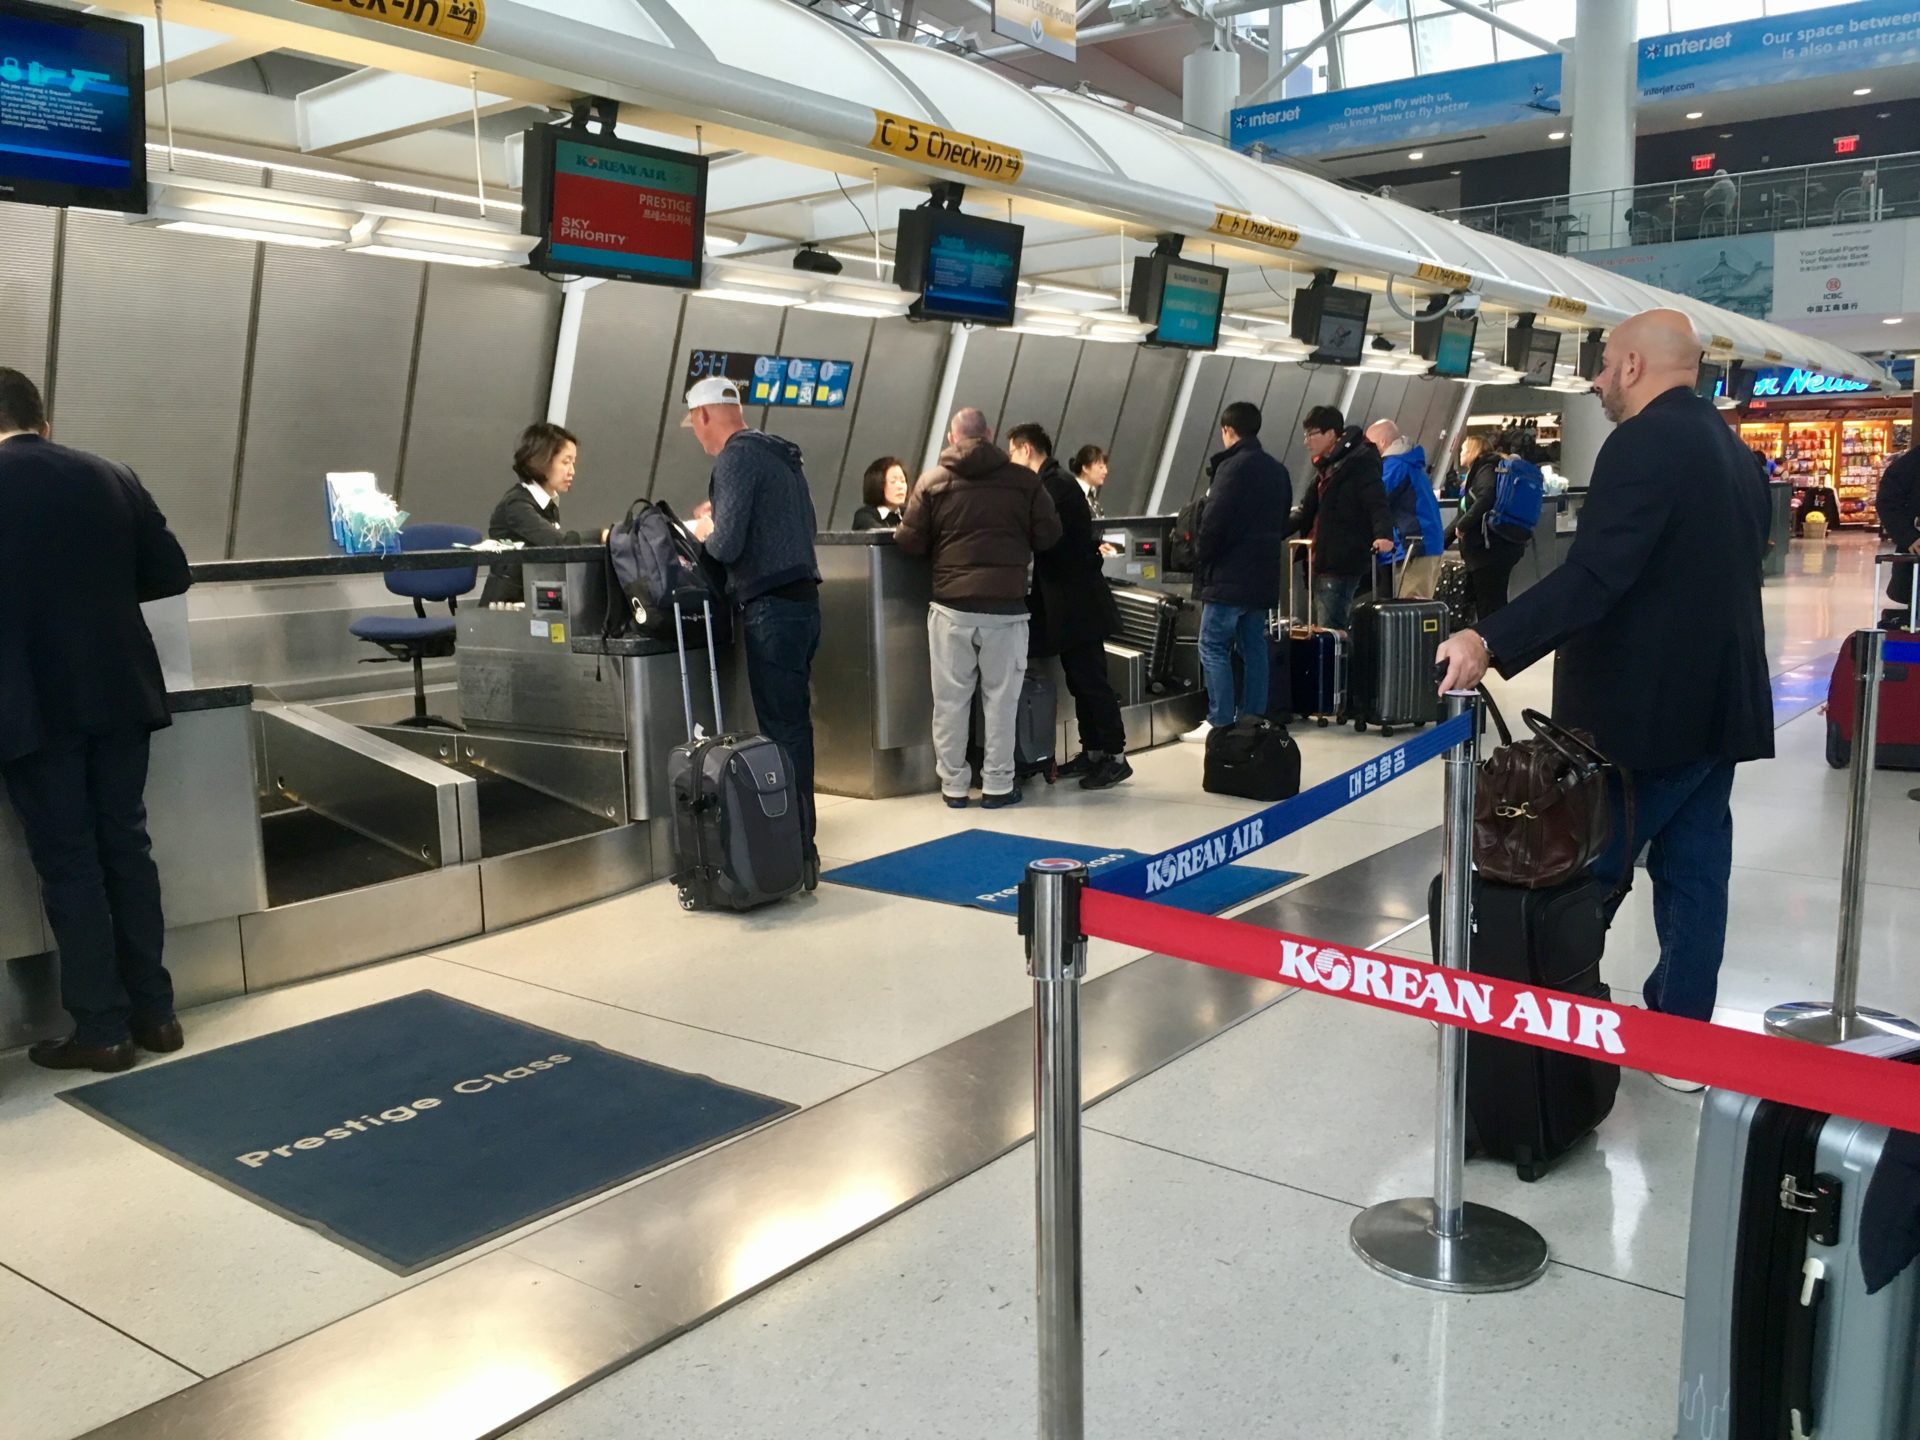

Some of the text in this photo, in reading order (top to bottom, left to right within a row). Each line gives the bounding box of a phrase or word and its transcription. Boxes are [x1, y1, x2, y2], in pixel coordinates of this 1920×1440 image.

[1762, 11, 1920, 46] Our space between
[1782, 47, 1795, 60] is
[1800, 43, 1833, 58] also
[1837, 38, 1858, 50] an
[1643, 82, 1695, 97] interjet.com
[1327, 101, 1470, 134] you know how to fly better
[1343, 106, 1370, 117] Once
[1372, 101, 1392, 113] you
[1394, 98, 1408, 109] fly
[1410, 94, 1434, 106] with
[881, 119, 1003, 174] C 5 Check-in
[576, 154, 667, 181] KOREAN AIR
[1694, 157, 1712, 170] EXIT
[639, 193, 692, 213] PRESTIGE
[561, 216, 591, 229] SKY
[560, 227, 626, 245] PRIORITY
[1806, 302, 1858, 313] 中国工商银行
[1823, 292, 1843, 300] ICBC
[690, 351, 728, 377] 3-1-1
[1349, 747, 1406, 799] 대한항공
[1145, 818, 1264, 894] KOREAN AIR
[1279, 939, 1627, 1055] KOREAN AIR
[235, 1053, 573, 1168] Prestige Class
